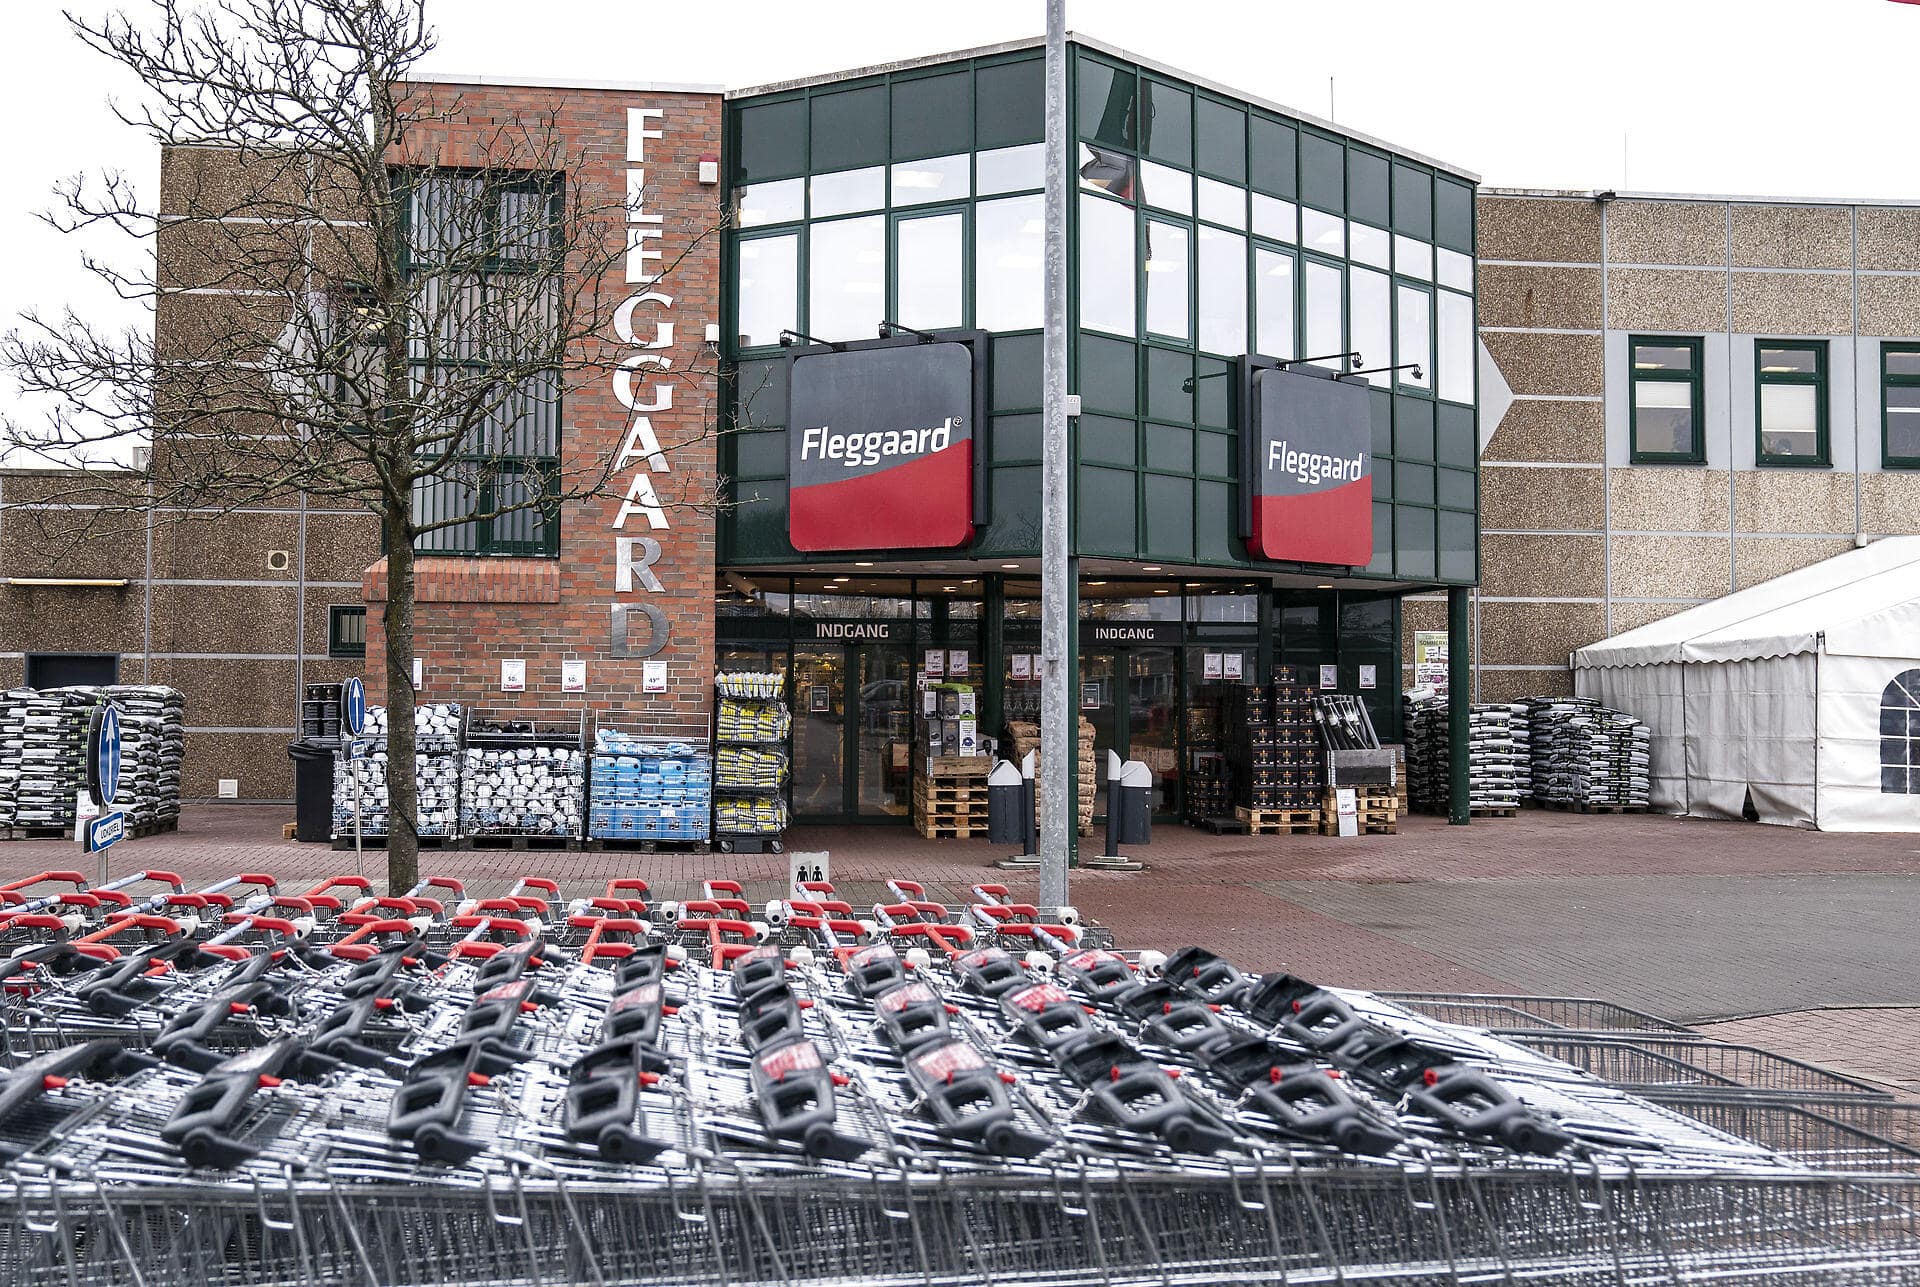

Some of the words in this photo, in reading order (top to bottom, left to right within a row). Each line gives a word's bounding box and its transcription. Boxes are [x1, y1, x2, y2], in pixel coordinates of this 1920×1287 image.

[611, 107, 675, 659] FLEGGAARD
[1268, 439, 1363, 485] Fleggaard
[816, 623, 889, 638] INDGANG
[1095, 627, 1155, 640] INDGANG
